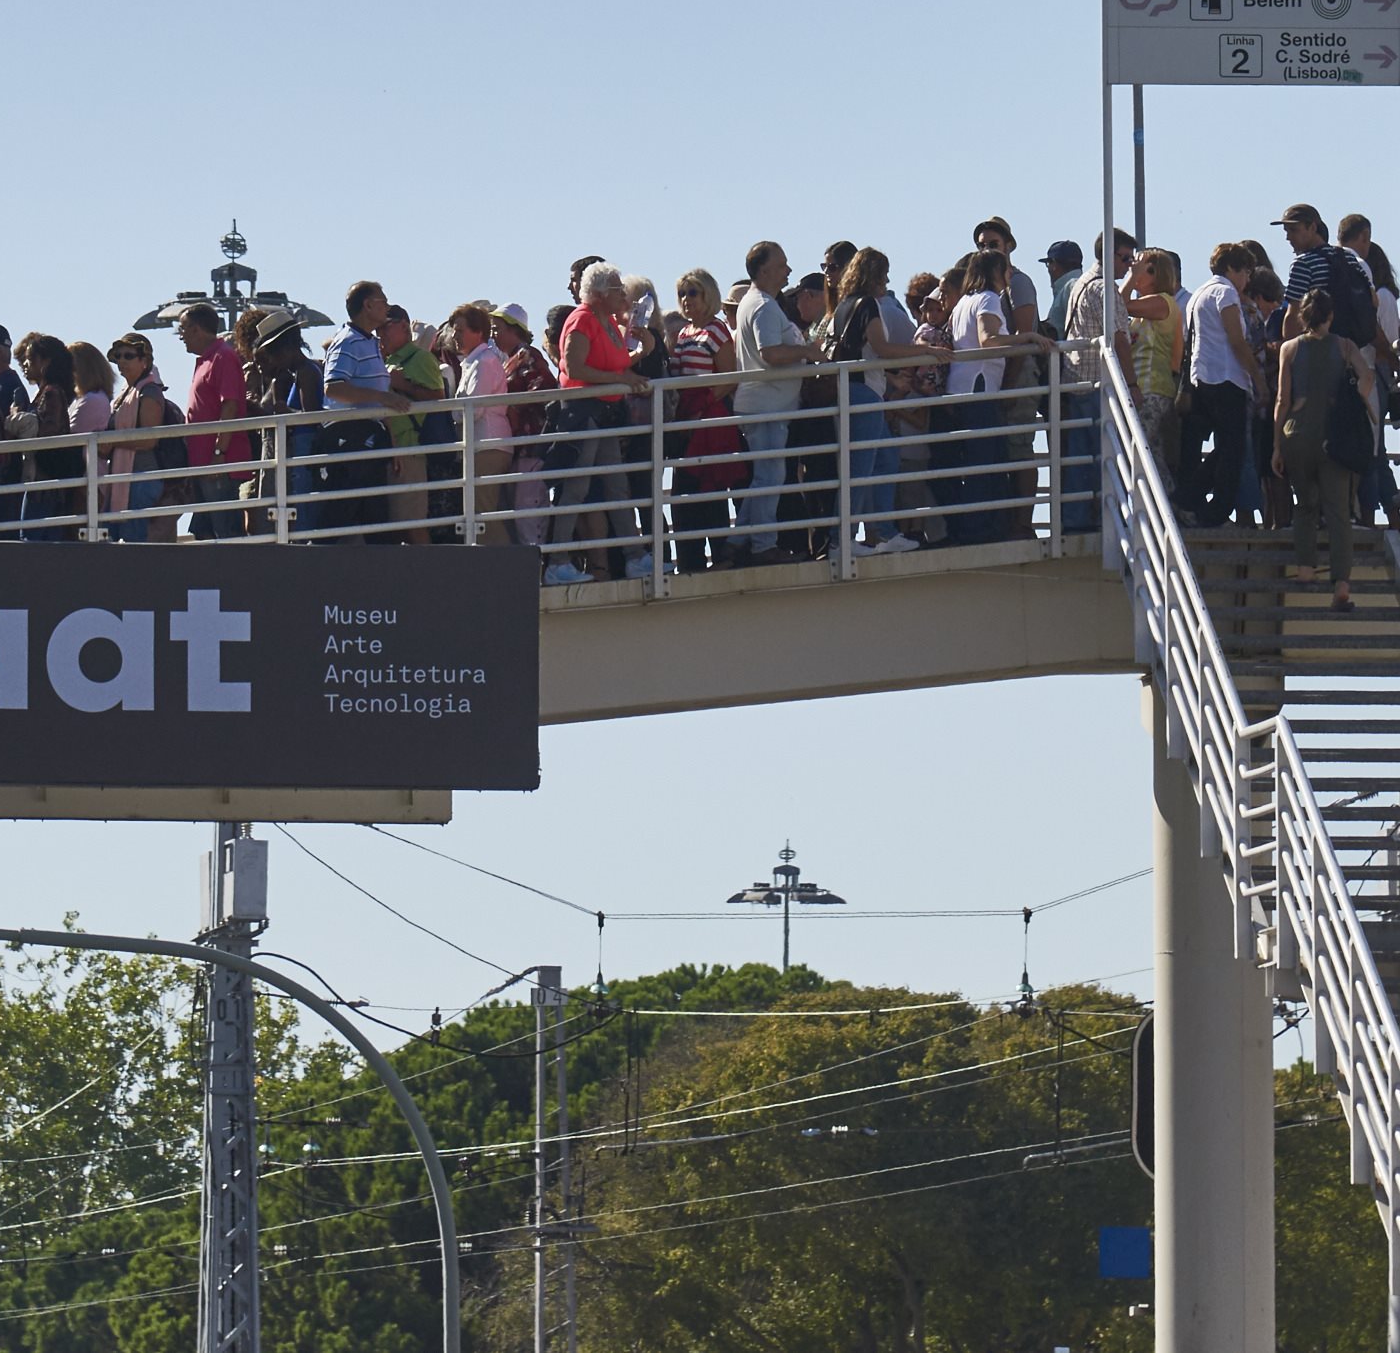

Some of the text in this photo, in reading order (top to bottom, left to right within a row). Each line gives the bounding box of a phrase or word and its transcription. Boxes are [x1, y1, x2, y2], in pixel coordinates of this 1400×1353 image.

[1226, 36, 1255, 46] Linha
[1280, 32, 1347, 48] Sentido
[1231, 48, 1251, 74] 2
[1275, 48, 1350, 64] C. Sodré
[1283, 66, 1342, 82] (Lisboa)
[324, 605, 397, 625] Museu
[324, 635, 383, 654] Arte
[324, 664, 486, 688] Arquitetura
[324, 693, 472, 718] Tecnologia
